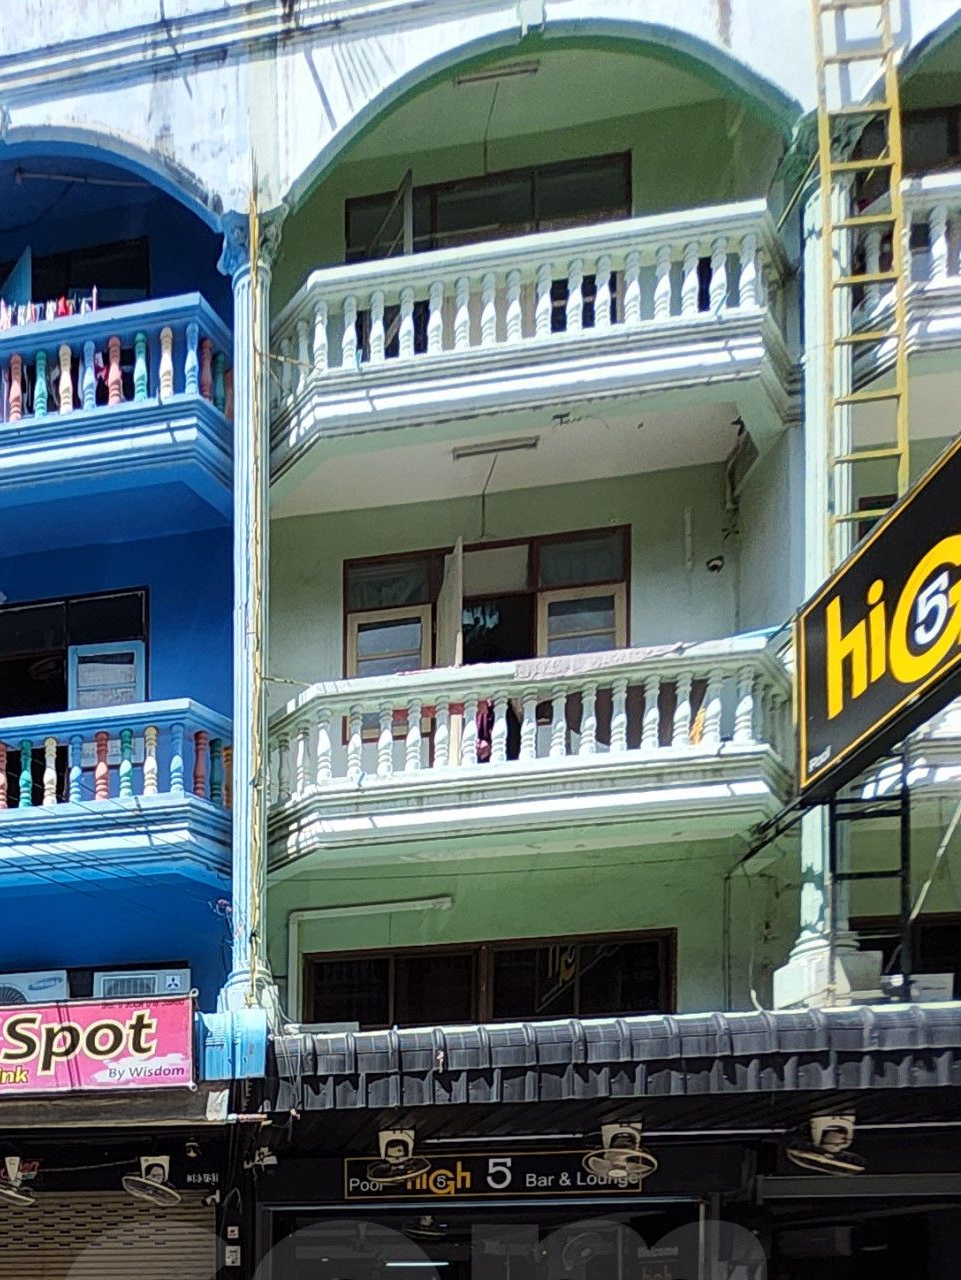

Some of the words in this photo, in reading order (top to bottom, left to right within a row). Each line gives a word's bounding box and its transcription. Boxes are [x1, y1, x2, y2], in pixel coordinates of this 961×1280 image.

[826, 534, 961, 720] hiG
[0, 1009, 157, 1076] Spot
[108, 1068, 125, 1080] By
[129, 1065, 185, 1078] Wisdom
[486, 1157, 512, 1189] 5
[525, 1173, 553, 1187] Bar
[558, 1172, 571, 1186] &
